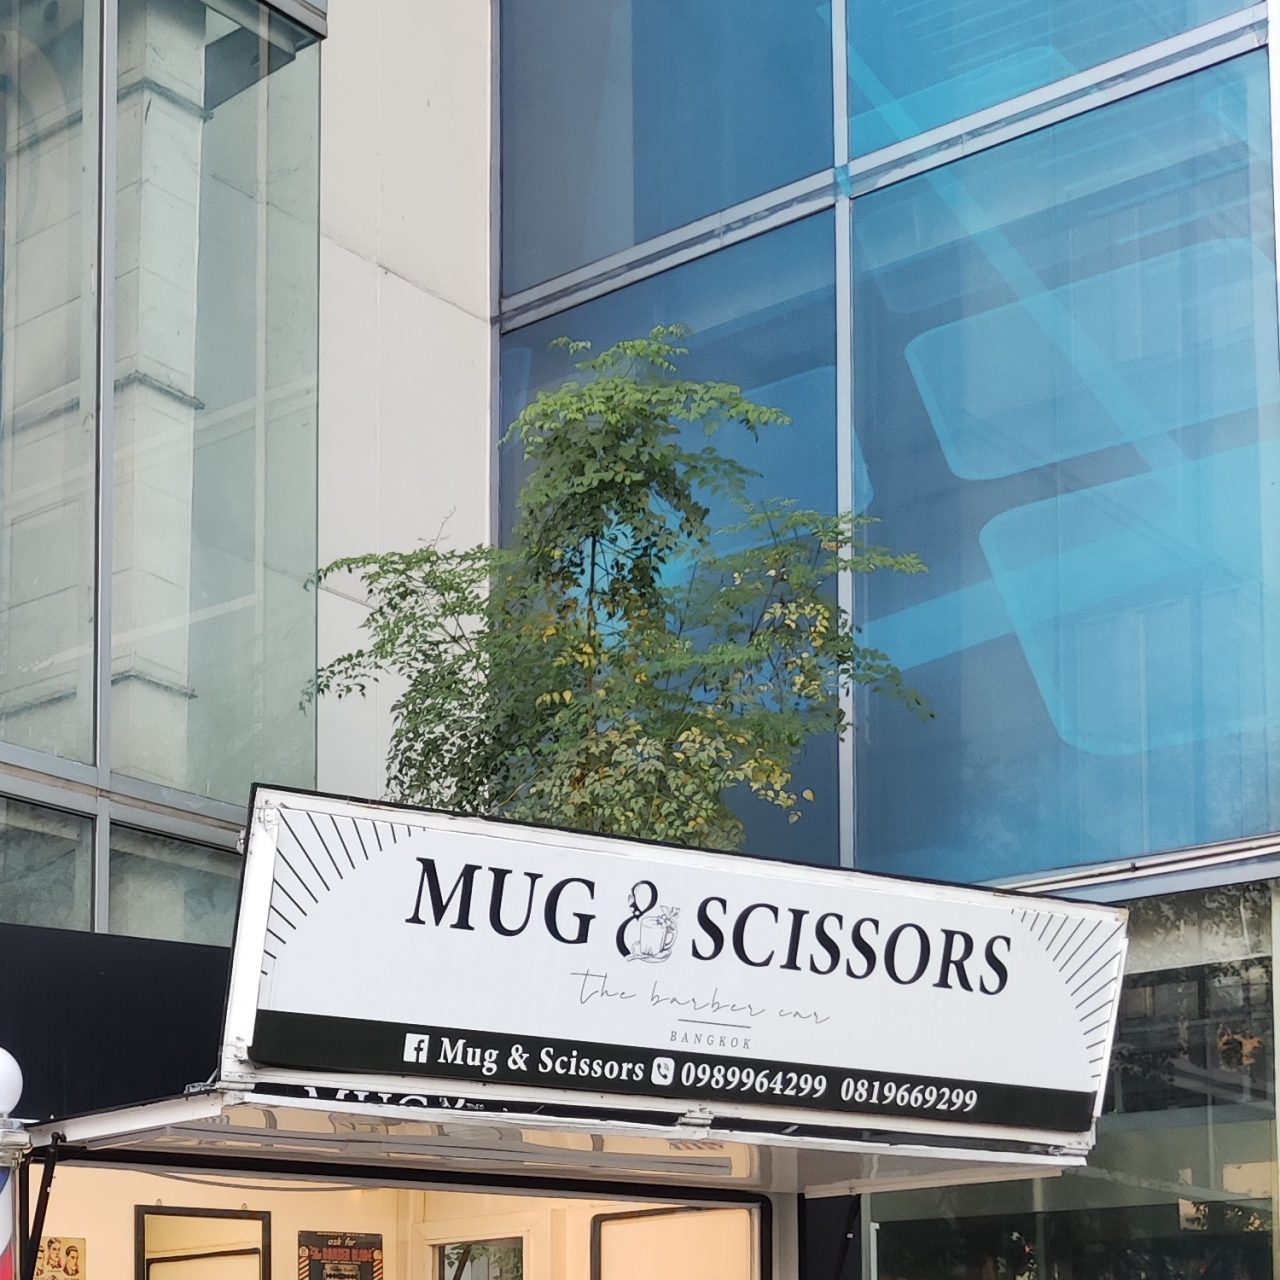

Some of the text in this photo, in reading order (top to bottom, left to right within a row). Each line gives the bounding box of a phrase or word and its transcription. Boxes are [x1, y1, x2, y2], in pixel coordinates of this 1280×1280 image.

[405, 857, 596, 945] MUG
[691, 896, 1011, 996] SCISSORS
[651, 980, 765, 1018] barber
[778, 1007, 831, 1024] car
[670, 1031, 752, 1049] BANGKOK
[437, 1037, 978, 1112] Mug & Scissors 0989964299 0819669299
